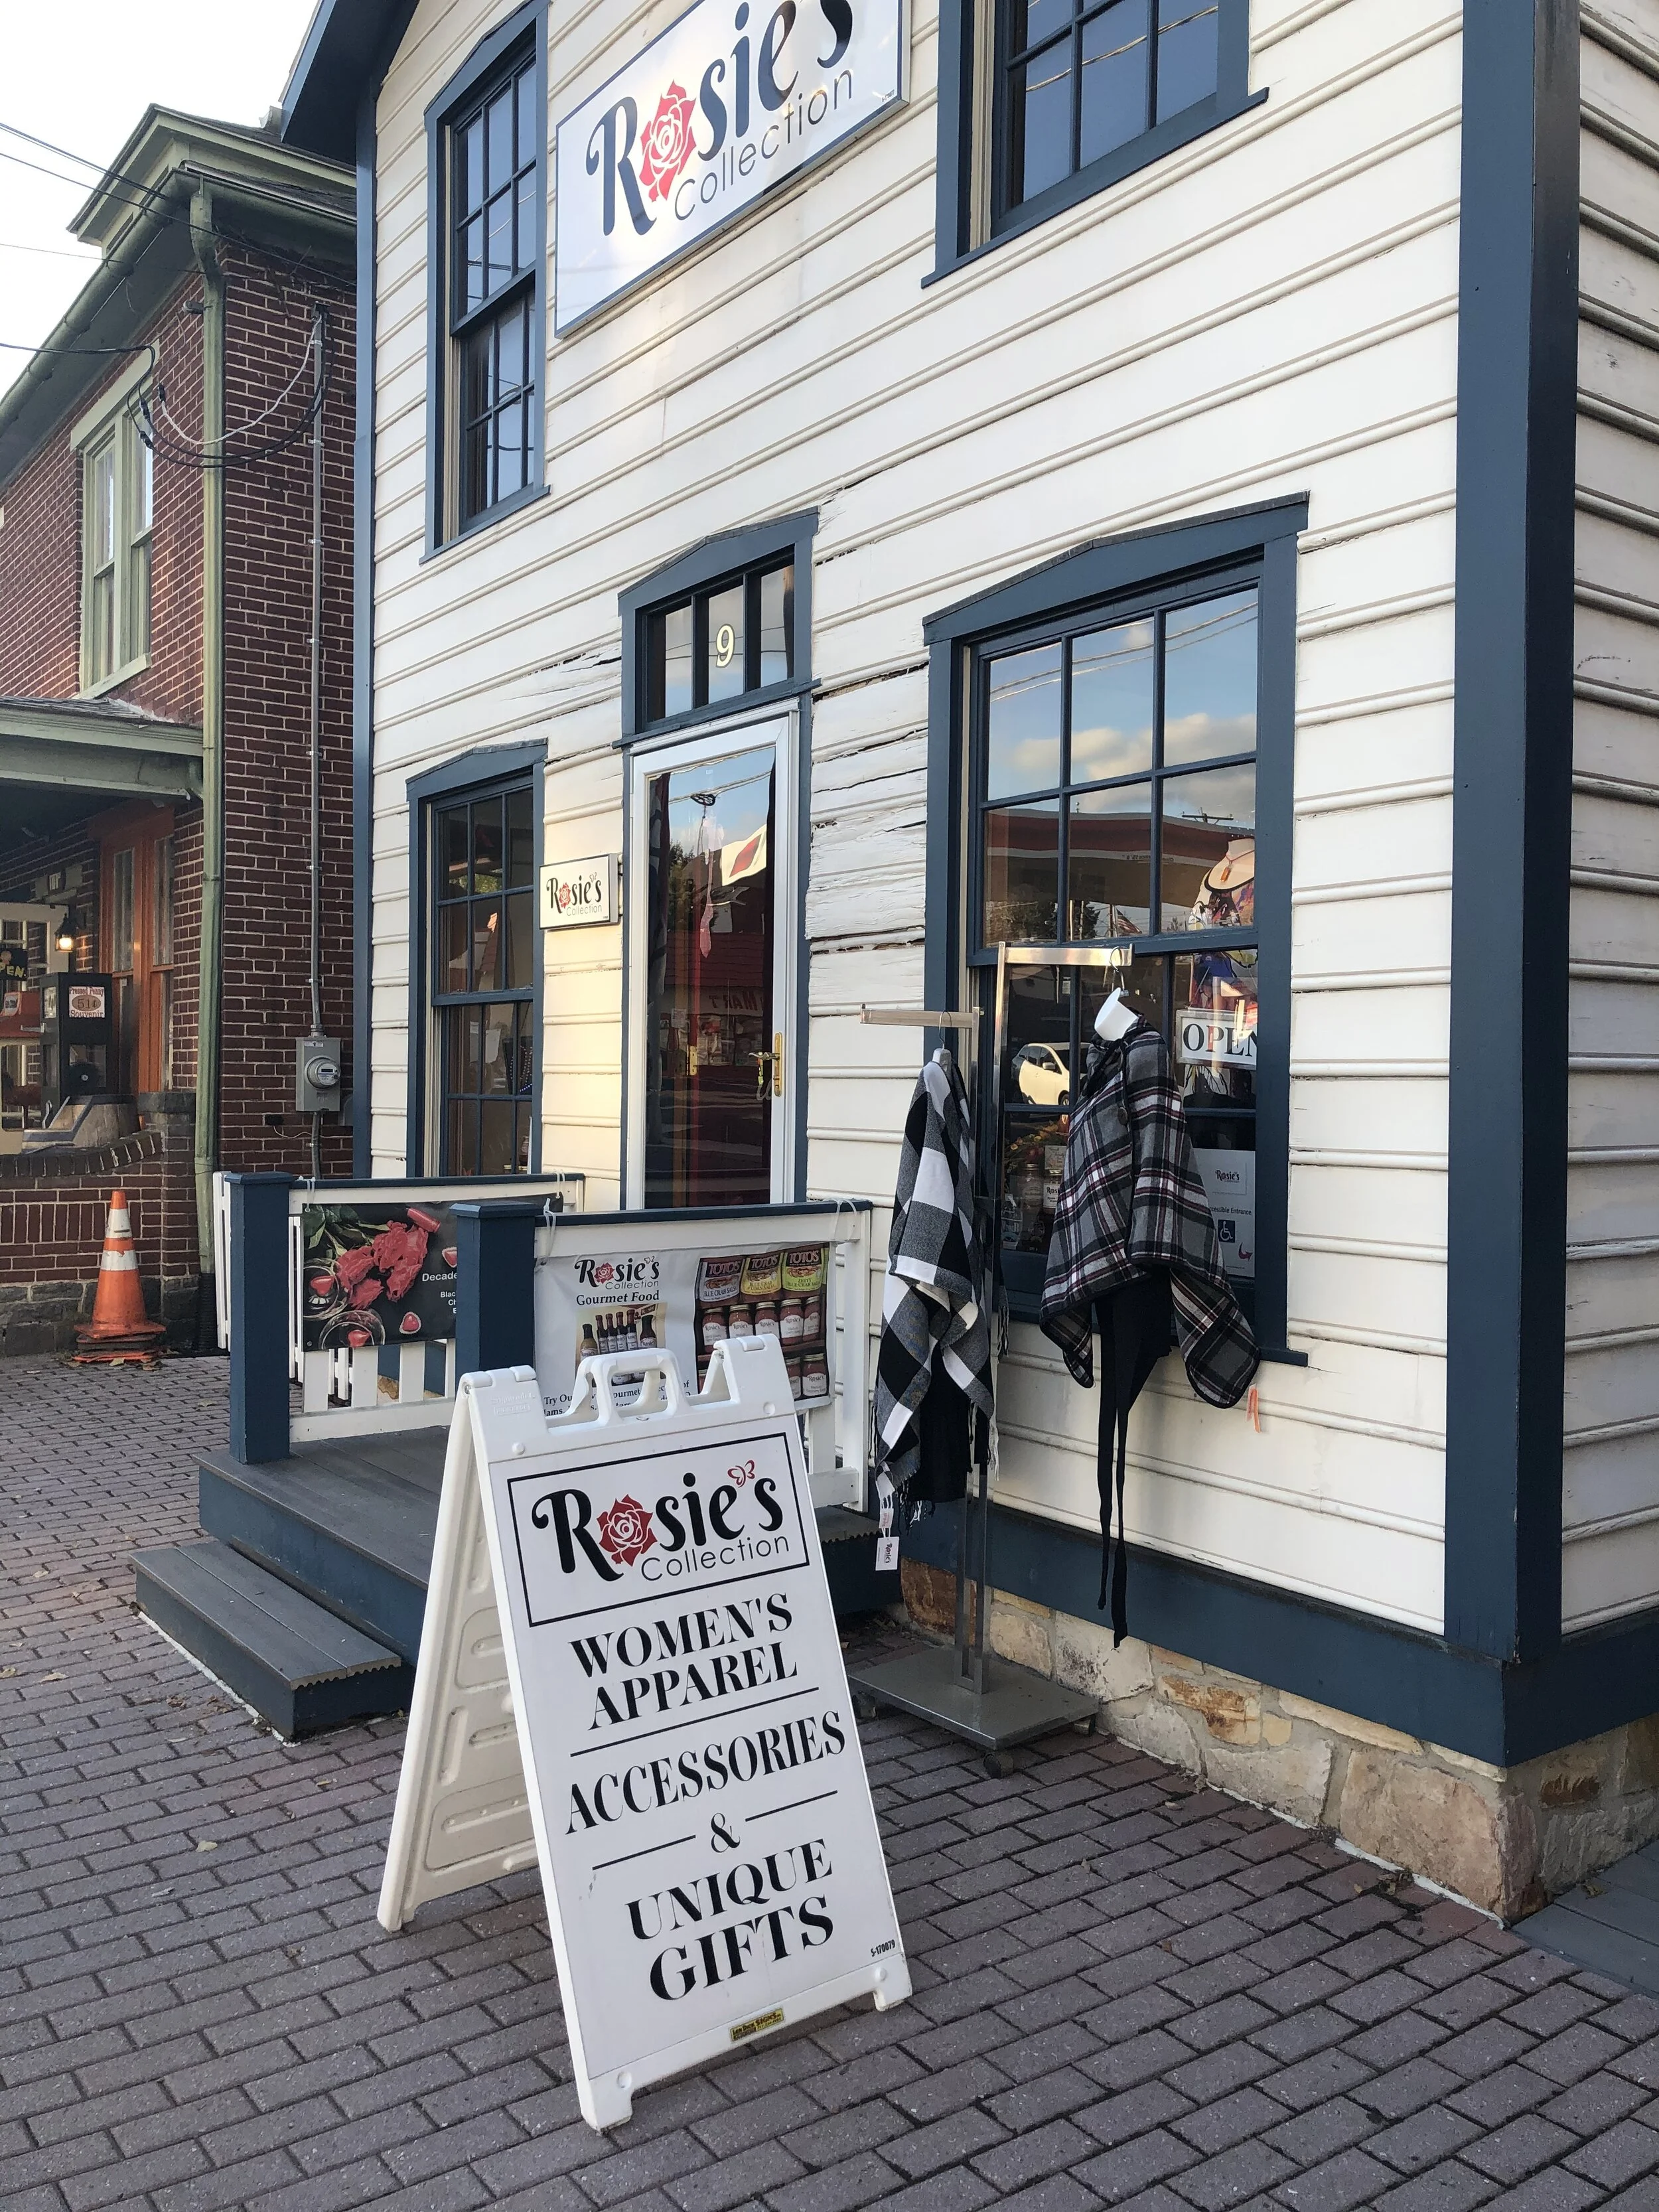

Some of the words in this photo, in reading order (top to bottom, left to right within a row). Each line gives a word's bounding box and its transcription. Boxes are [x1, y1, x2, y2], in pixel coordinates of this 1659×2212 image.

[586, 0, 853, 236] Rosies
[675, 70, 852, 220] Collection
[715, 623, 735, 668] 9
[546, 872, 601, 914] Rosie's
[567, 905, 602, 916] Collection
[1215, 1170, 1240, 1181] Rosie's
[574, 1256, 660, 1288] Rosie's
[605, 1280, 659, 1290] Collection
[576, 1293, 628, 1305] Gourmet
[631, 1290, 660, 1301] Food
[544, 1396, 557, 1406] Try
[613, 1388, 640, 1398] ourmet
[532, 1460, 783, 1582] Rosie's
[641, 1536, 788, 1582] Collection
[567, 1593, 792, 1678] WOMEN'S
[588, 1641, 798, 1731] APPAREL
[565, 1710, 845, 1836] ACCESSORIES
[711, 1813, 741, 1853] &
[624, 1838, 833, 1940] UNIQUE
[650, 1894, 833, 2000] GIFTS
